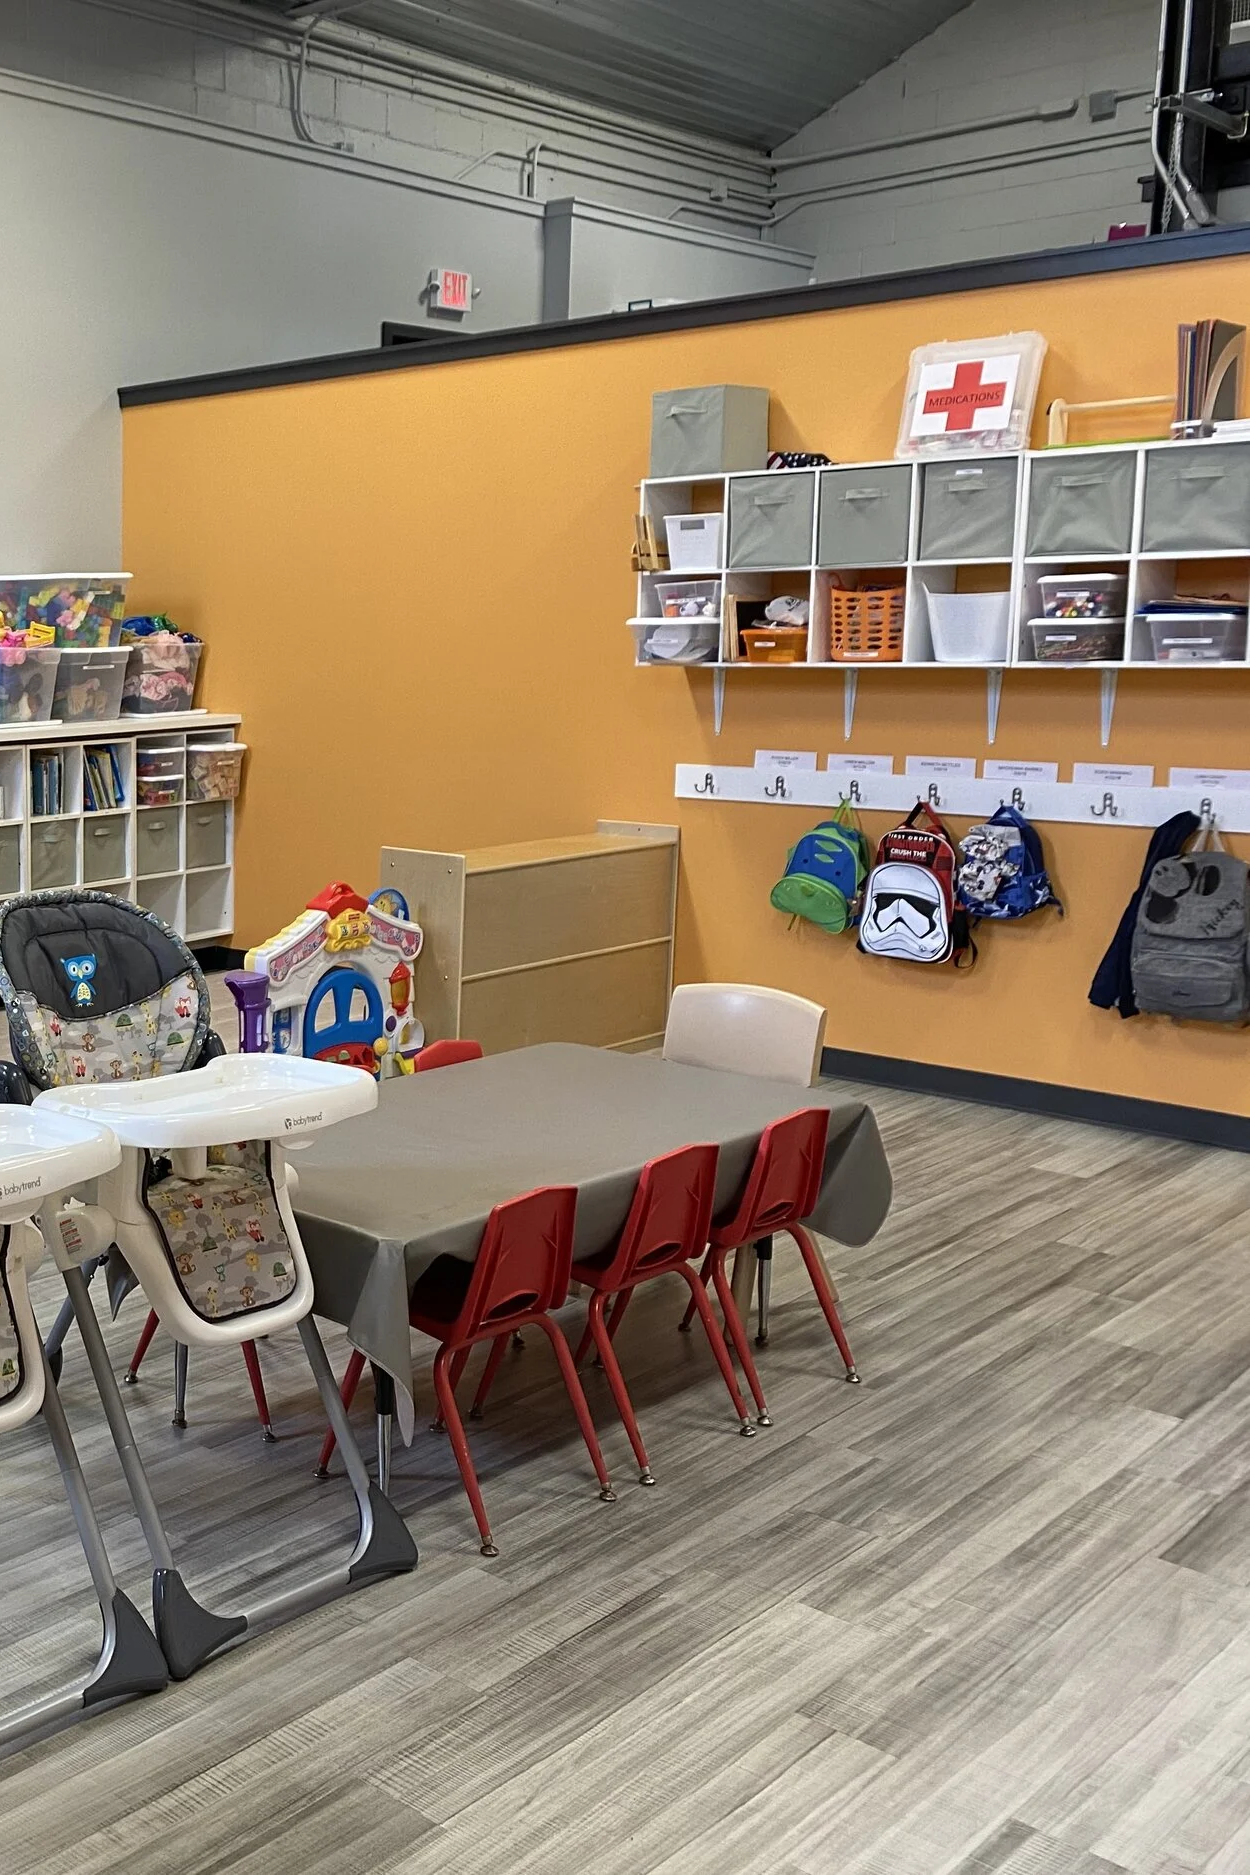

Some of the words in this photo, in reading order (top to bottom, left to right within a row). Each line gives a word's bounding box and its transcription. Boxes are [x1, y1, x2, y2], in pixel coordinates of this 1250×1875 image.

[443, 271, 468, 304] EXIT
[929, 391, 1001, 407] MEDICATIONS
[890, 848, 912, 856] CRUSH
[293, 1112, 323, 1126] babytrend
[3, 1176, 41, 1195] babytrend
